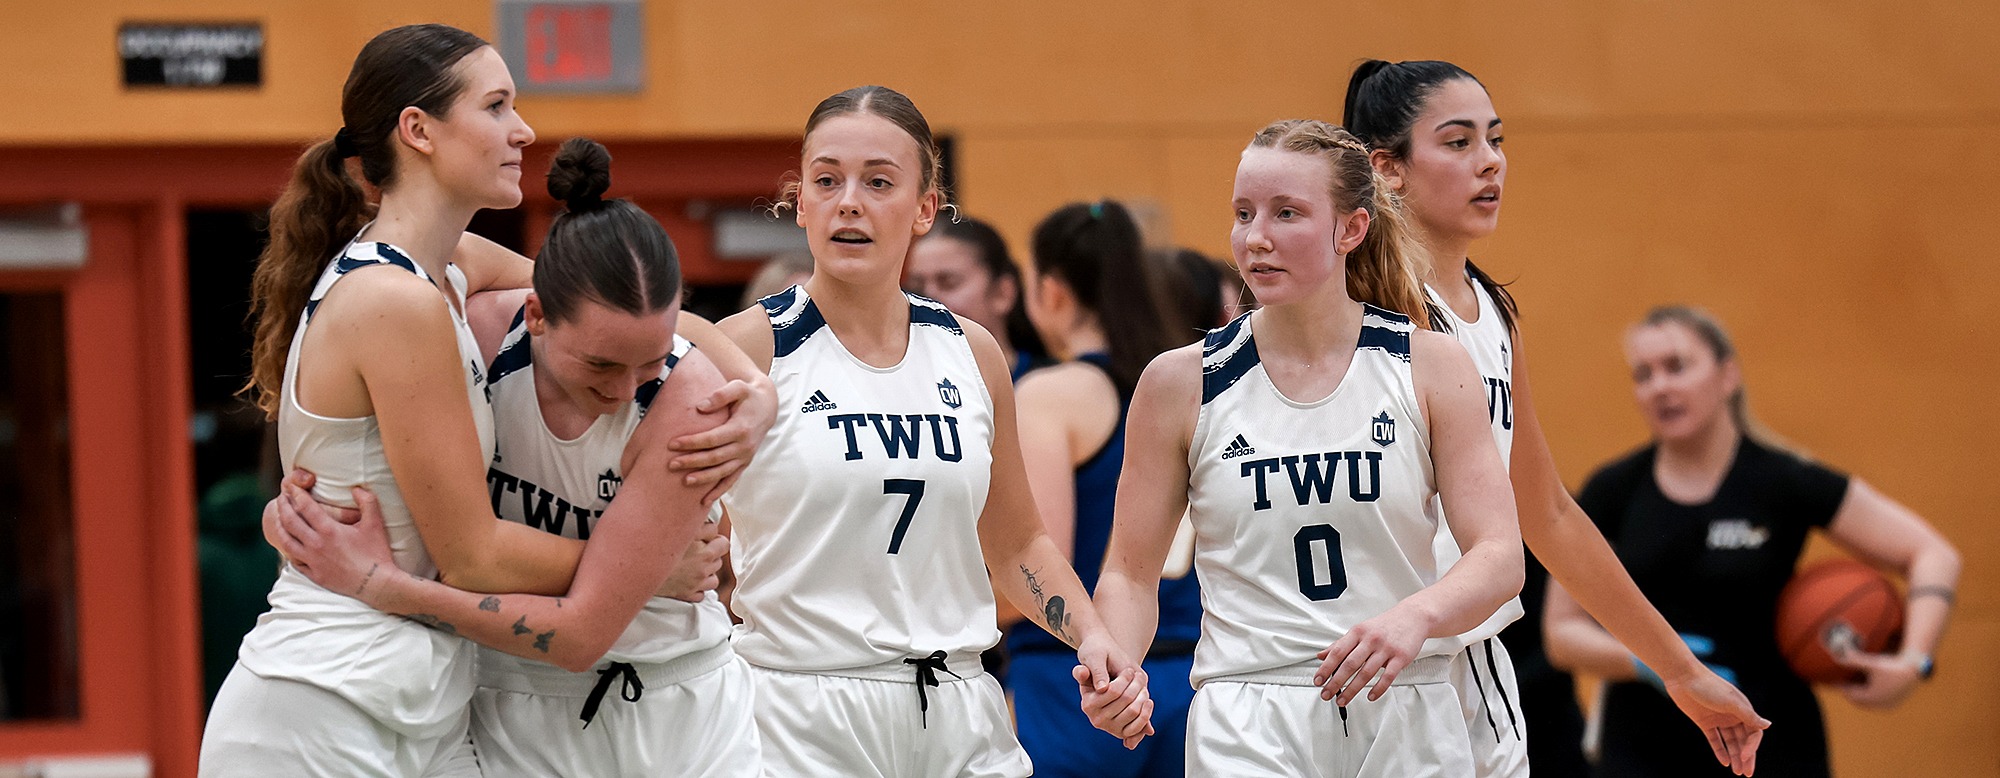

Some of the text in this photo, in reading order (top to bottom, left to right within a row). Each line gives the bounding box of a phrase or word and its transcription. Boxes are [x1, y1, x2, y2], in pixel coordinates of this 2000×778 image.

[801, 401, 838, 413] adidas
[1373, 421, 1394, 441] CW
[827, 413, 963, 463] TWU
[1221, 446, 1256, 460] adidas
[1241, 451, 1383, 511] TWU
[883, 479, 926, 555] 7
[1293, 523, 1348, 602] 0
